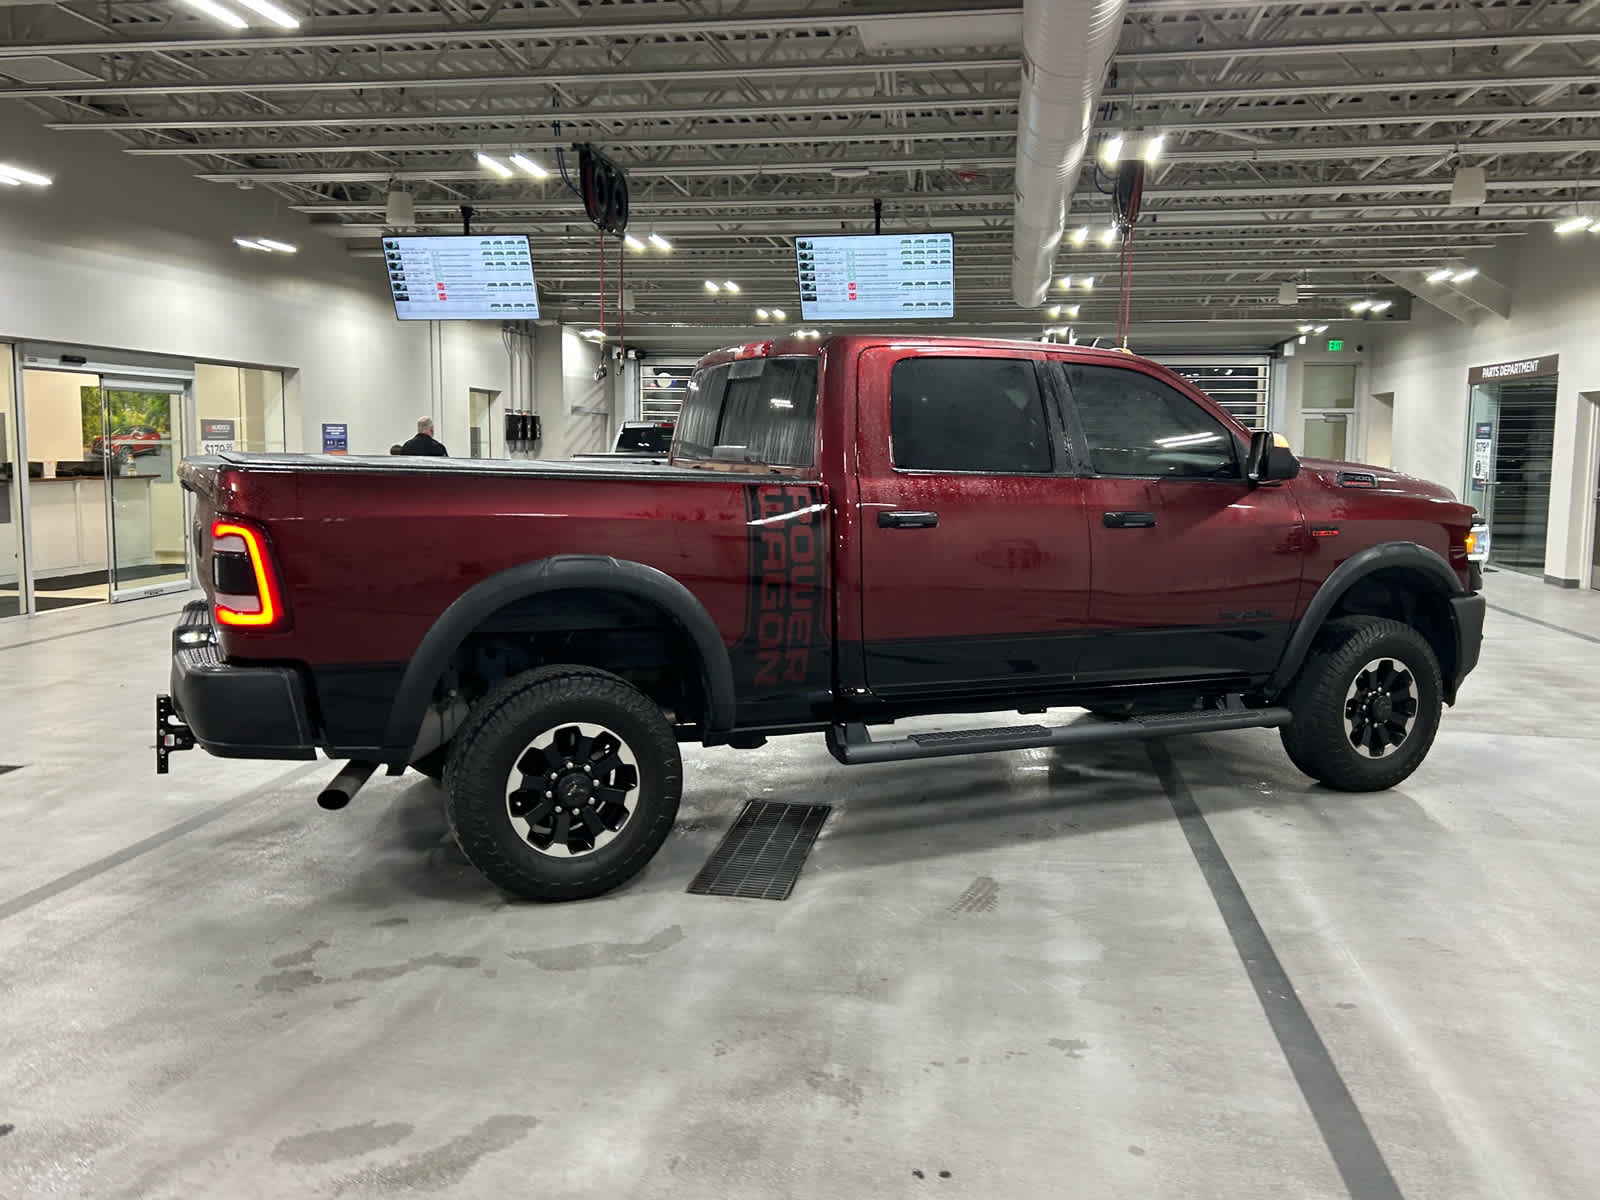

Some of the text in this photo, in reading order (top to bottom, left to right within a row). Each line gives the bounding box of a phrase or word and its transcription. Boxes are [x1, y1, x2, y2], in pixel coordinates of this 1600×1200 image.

[1329, 340, 1343, 351] EXIT
[1482, 360, 1539, 378] PARTS DEPARTMENT
[754, 486, 788, 686] WAGON
[783, 486, 816, 684] POWER
